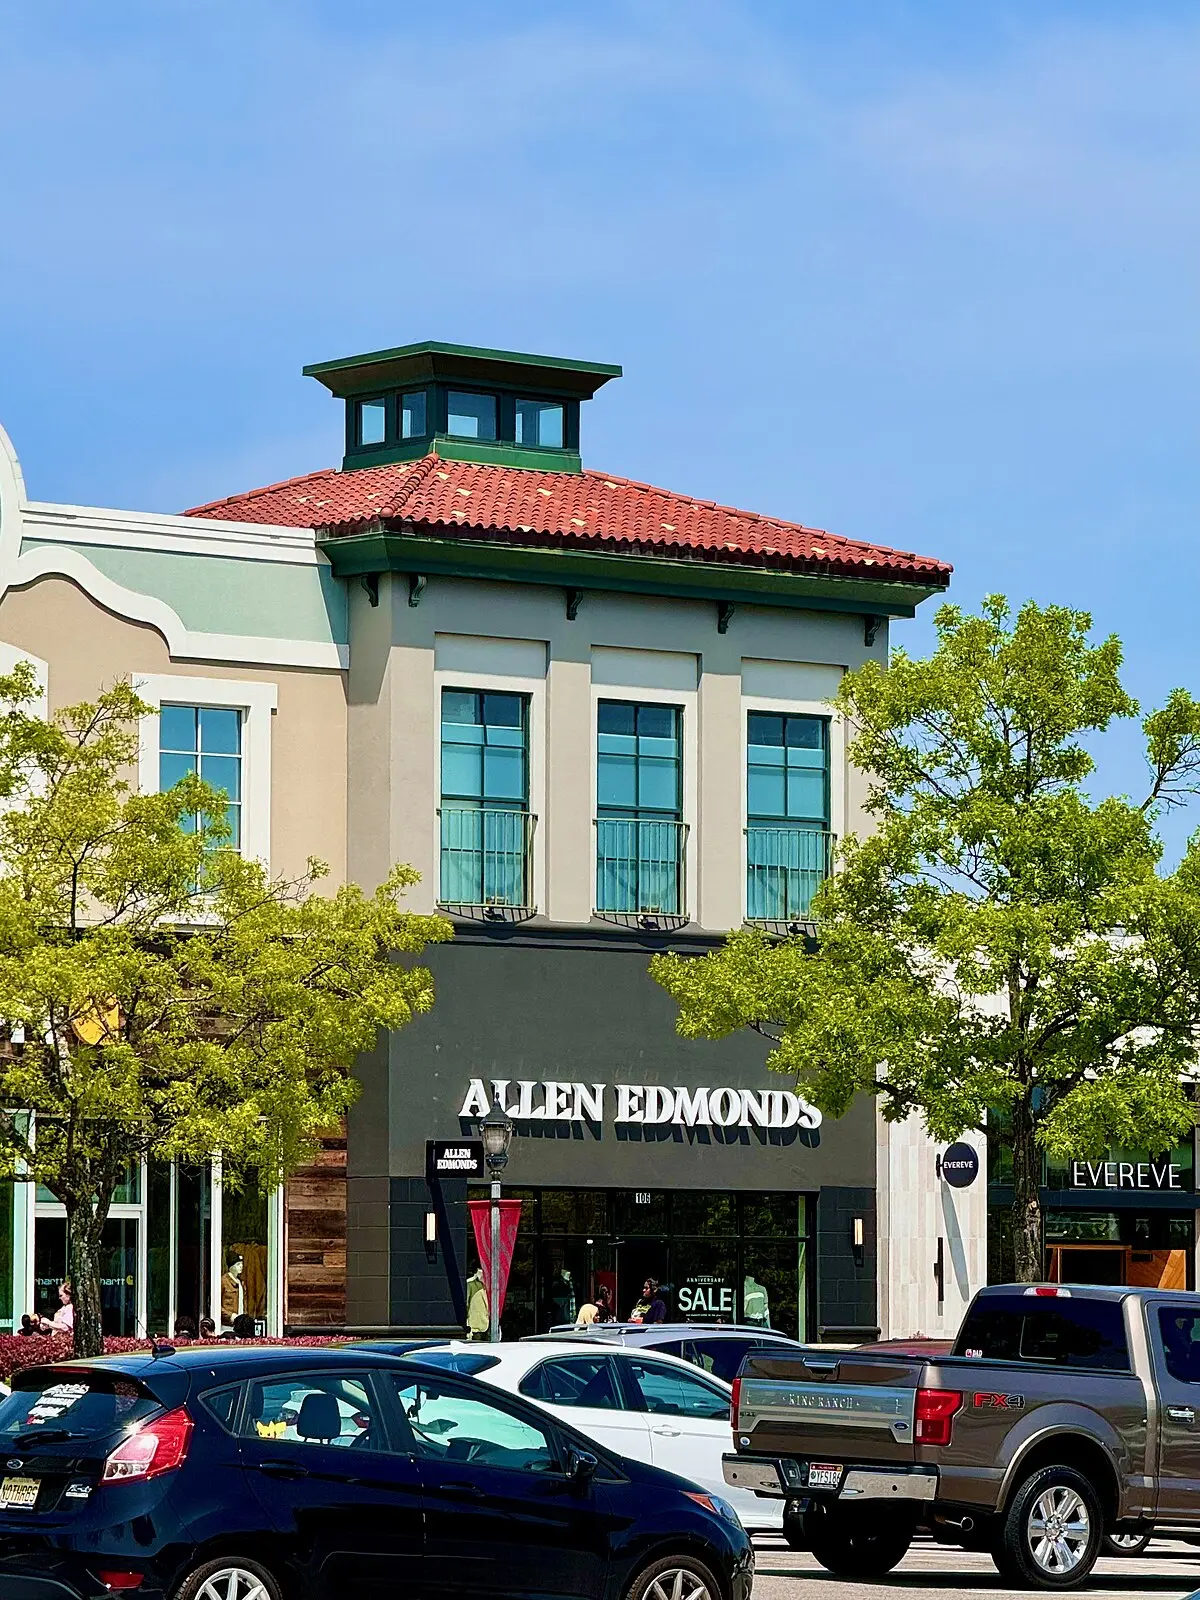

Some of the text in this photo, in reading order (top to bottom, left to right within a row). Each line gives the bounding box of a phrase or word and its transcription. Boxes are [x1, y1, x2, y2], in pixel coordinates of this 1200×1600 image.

[458, 1078, 823, 1129] ALLEN EDMONDS
[443, 1148, 471, 1158] ALLEN
[436, 1159, 478, 1170] EDMONDS
[943, 1160, 974, 1169] EVEREVE
[1072, 1160, 1182, 1189] EVEREVE
[635, 1192, 651, 1204] 106
[678, 1287, 732, 1312] SALE
[789, 1393, 853, 1409] KING RANCH
[973, 1391, 1025, 1409] FX4
